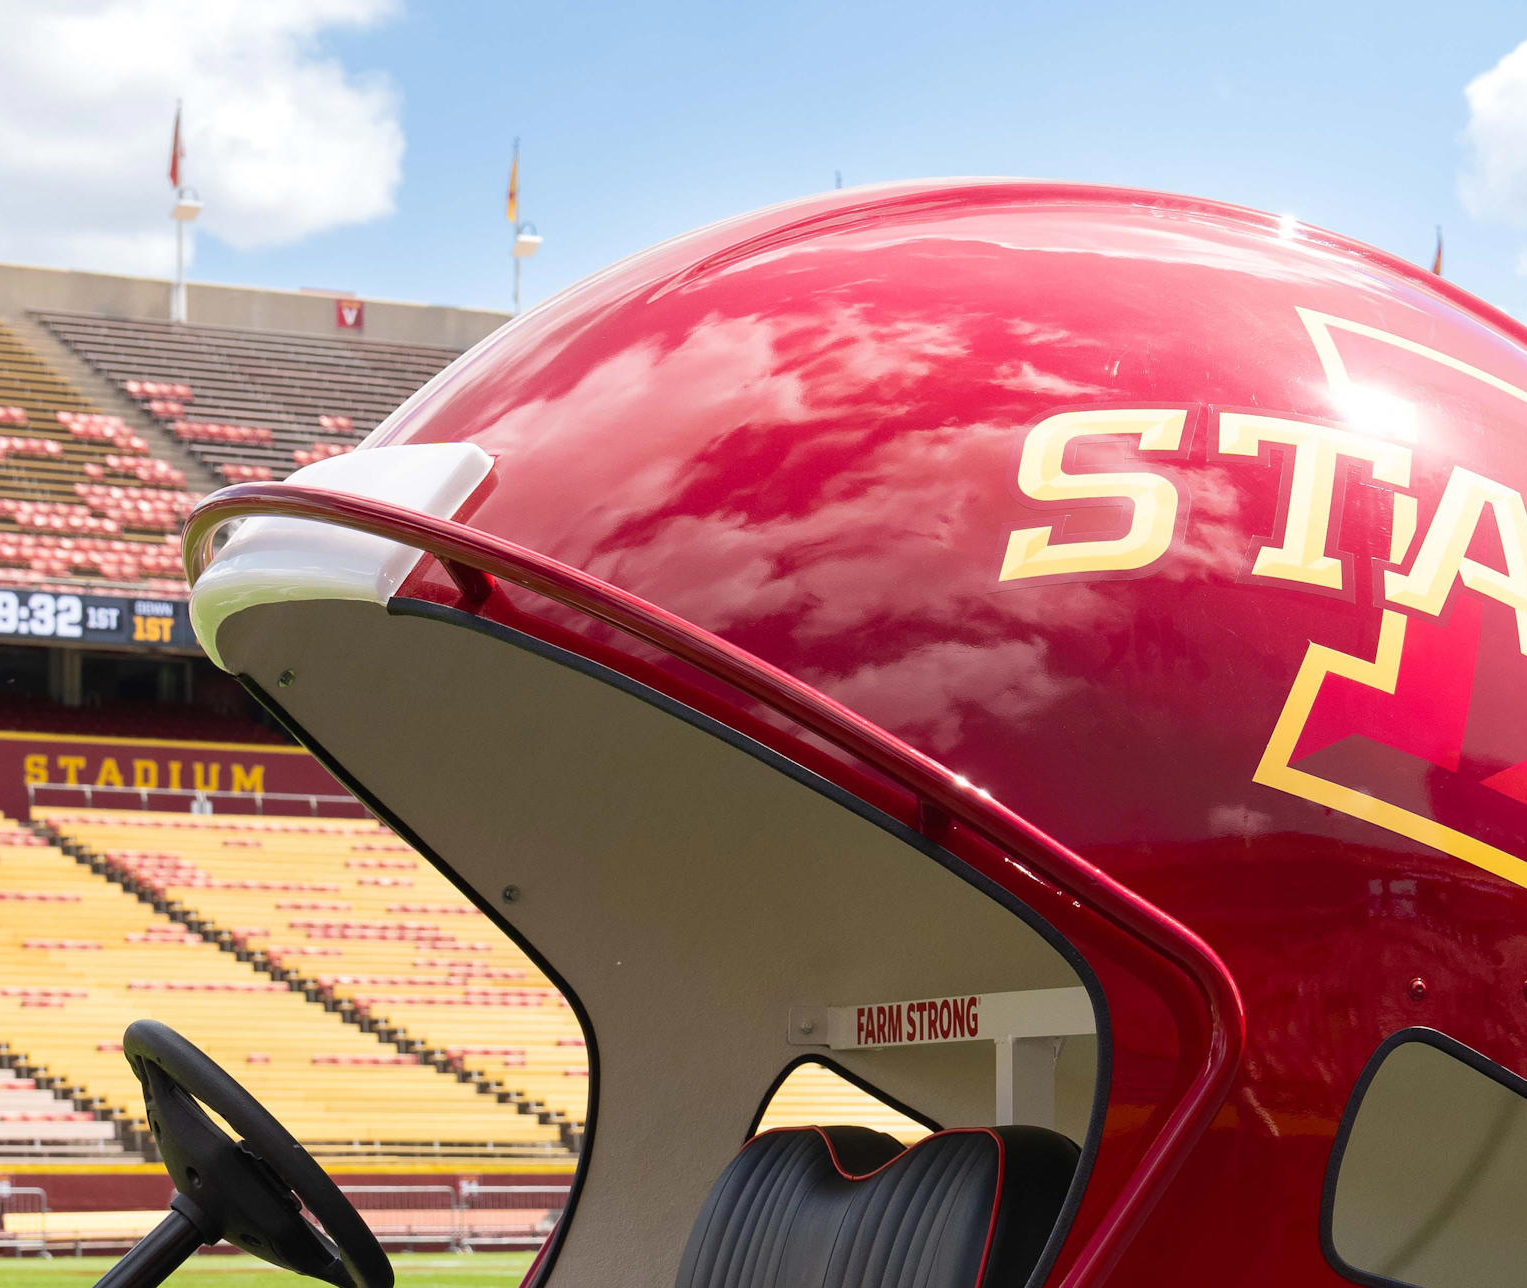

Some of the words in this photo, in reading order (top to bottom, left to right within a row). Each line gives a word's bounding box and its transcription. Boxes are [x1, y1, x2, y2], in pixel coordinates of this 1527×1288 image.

[86, 606, 119, 630] 1ST
[132, 616, 175, 643] 1ST
[24, 754, 265, 794] STADIUM
[857, 1004, 903, 1045] FARM
[906, 996, 978, 1042] STRONG
